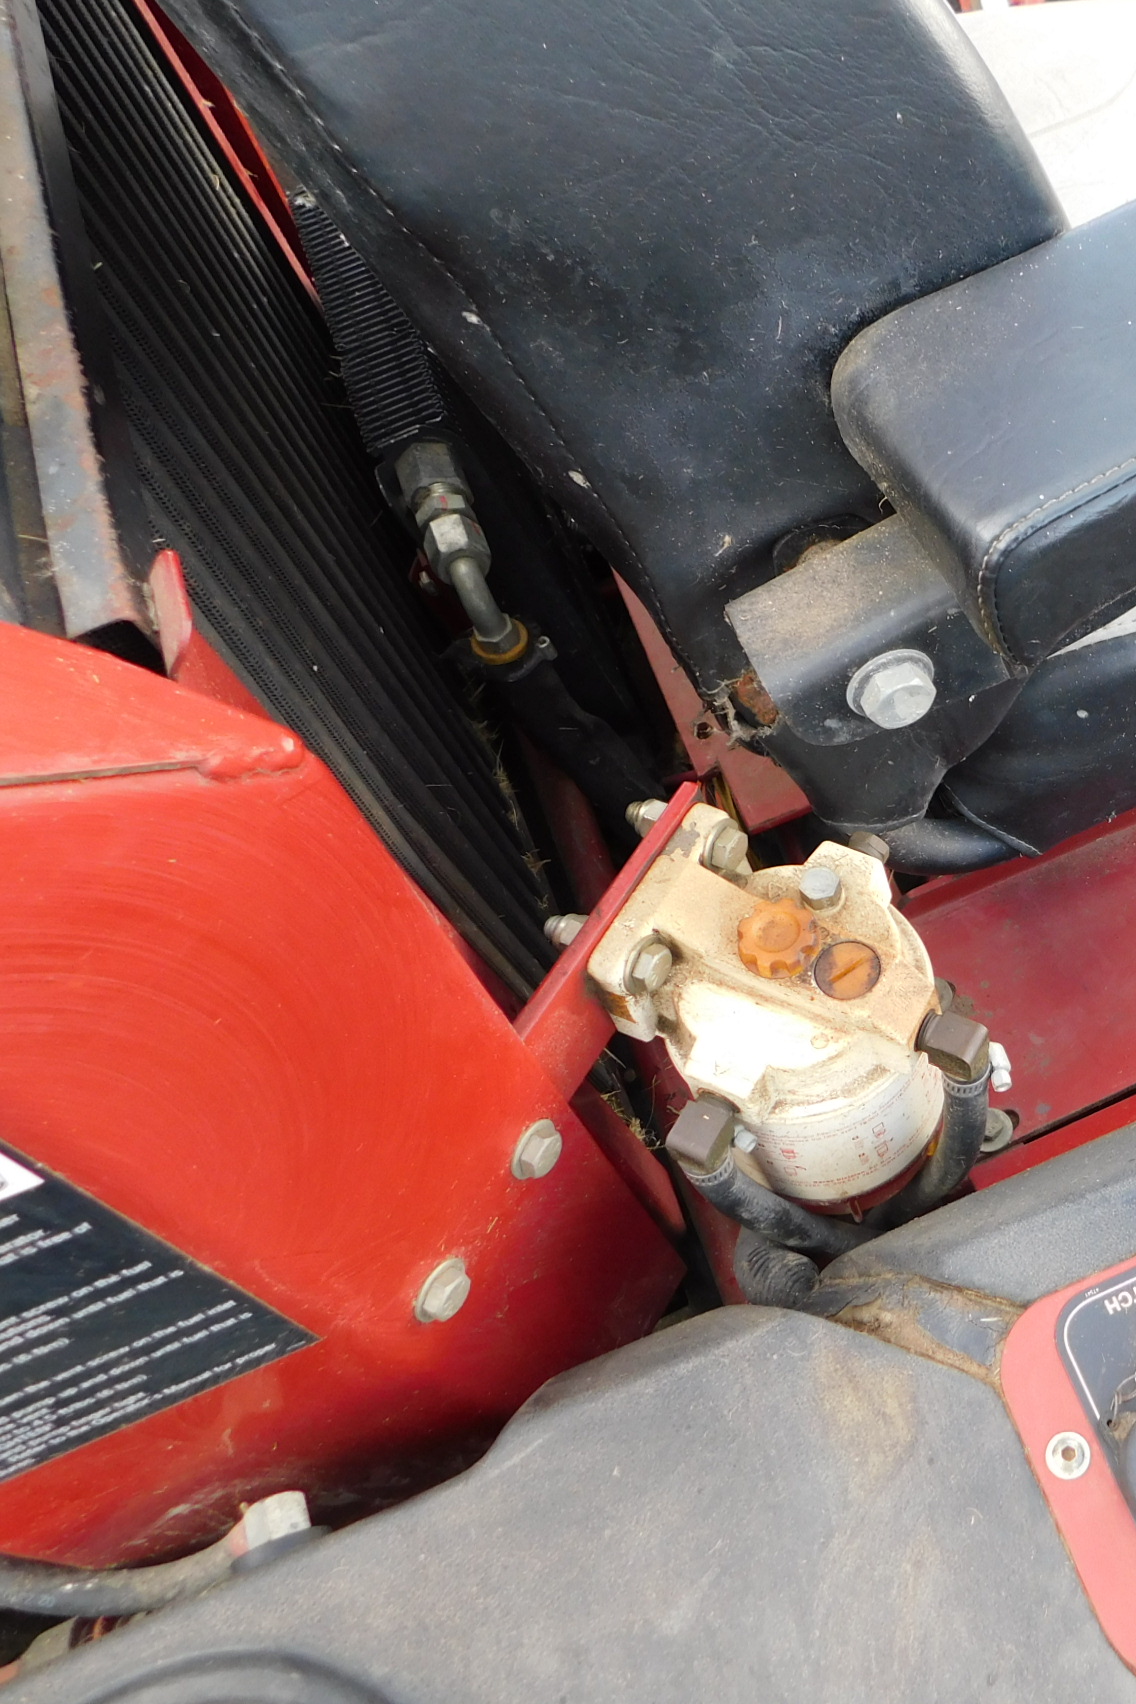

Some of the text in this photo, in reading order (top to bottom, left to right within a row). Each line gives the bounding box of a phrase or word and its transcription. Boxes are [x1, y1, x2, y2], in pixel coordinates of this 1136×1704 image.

[70, 1285, 95, 1298] on
[93, 1274, 122, 1288] the
[120, 1260, 153, 1277] fuel
[106, 1288, 137, 1304] fuel
[136, 1274, 168, 1292] that
[176, 1312, 206, 1329] fuel
[180, 1329, 210, 1346] fuel
[208, 1317, 238, 1333] that
[212, 1361, 233, 1373] for
